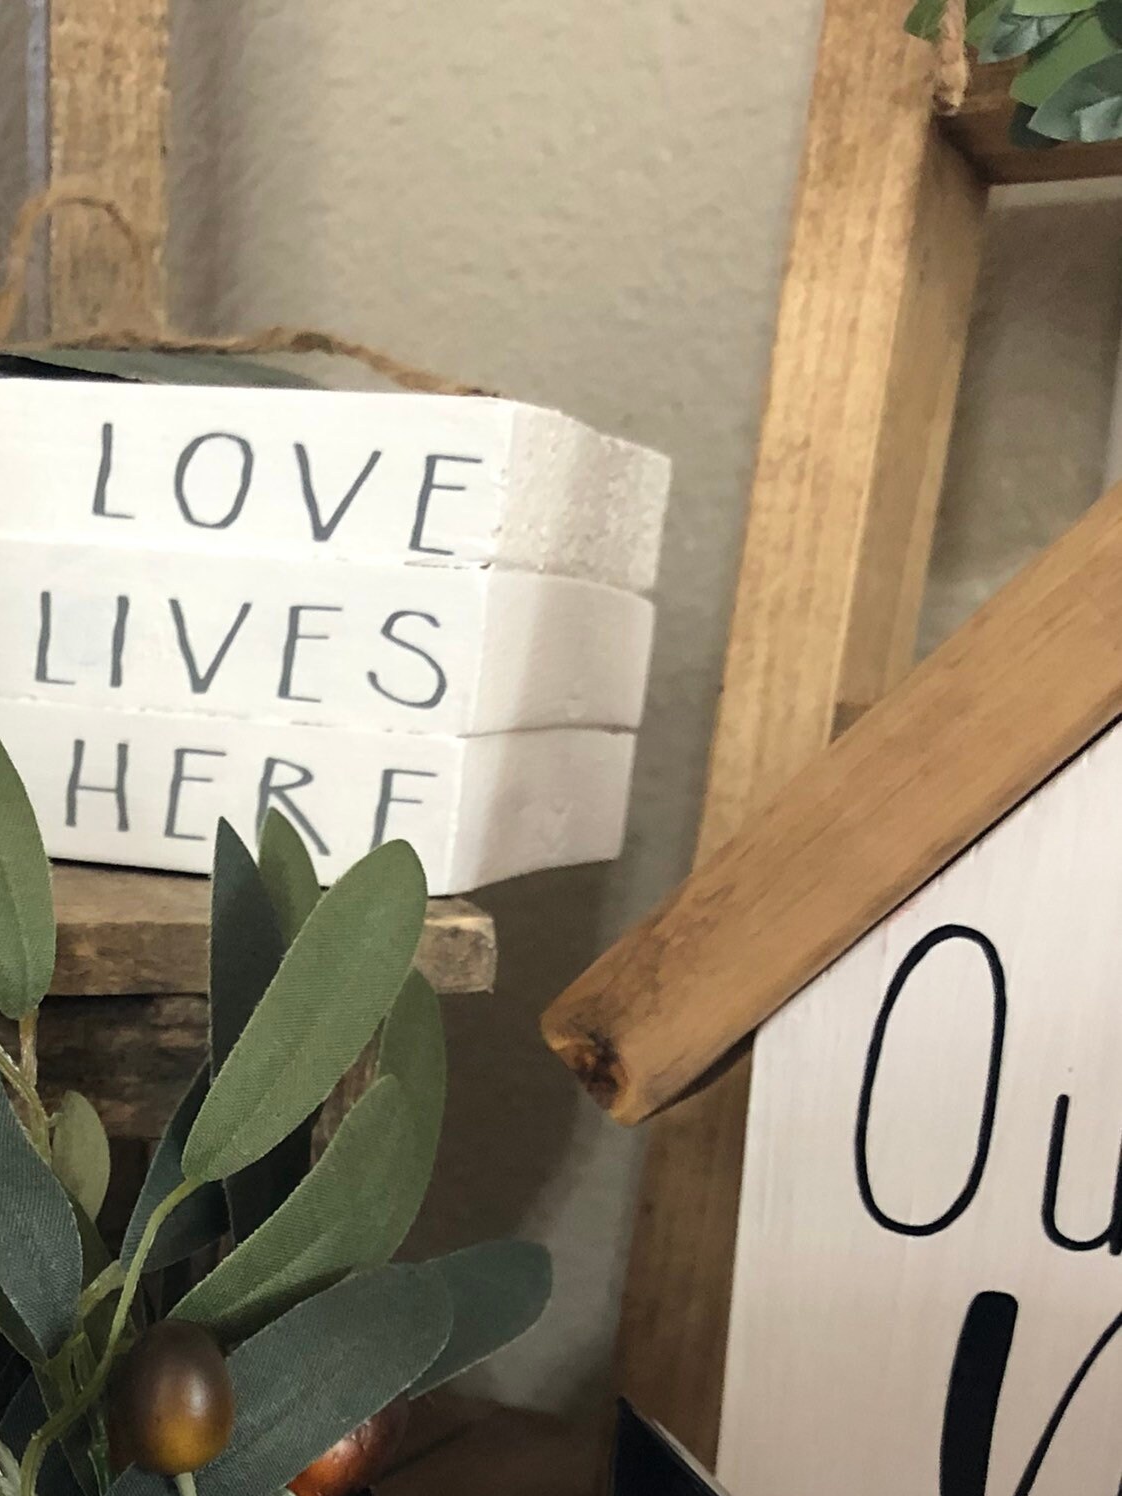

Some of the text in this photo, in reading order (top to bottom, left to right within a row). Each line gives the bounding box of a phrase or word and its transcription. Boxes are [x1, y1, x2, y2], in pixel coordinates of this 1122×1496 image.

[91, 422, 484, 555] LOVE
[35, 590, 448, 709] LIVES
[65, 738, 438, 856] HERE
